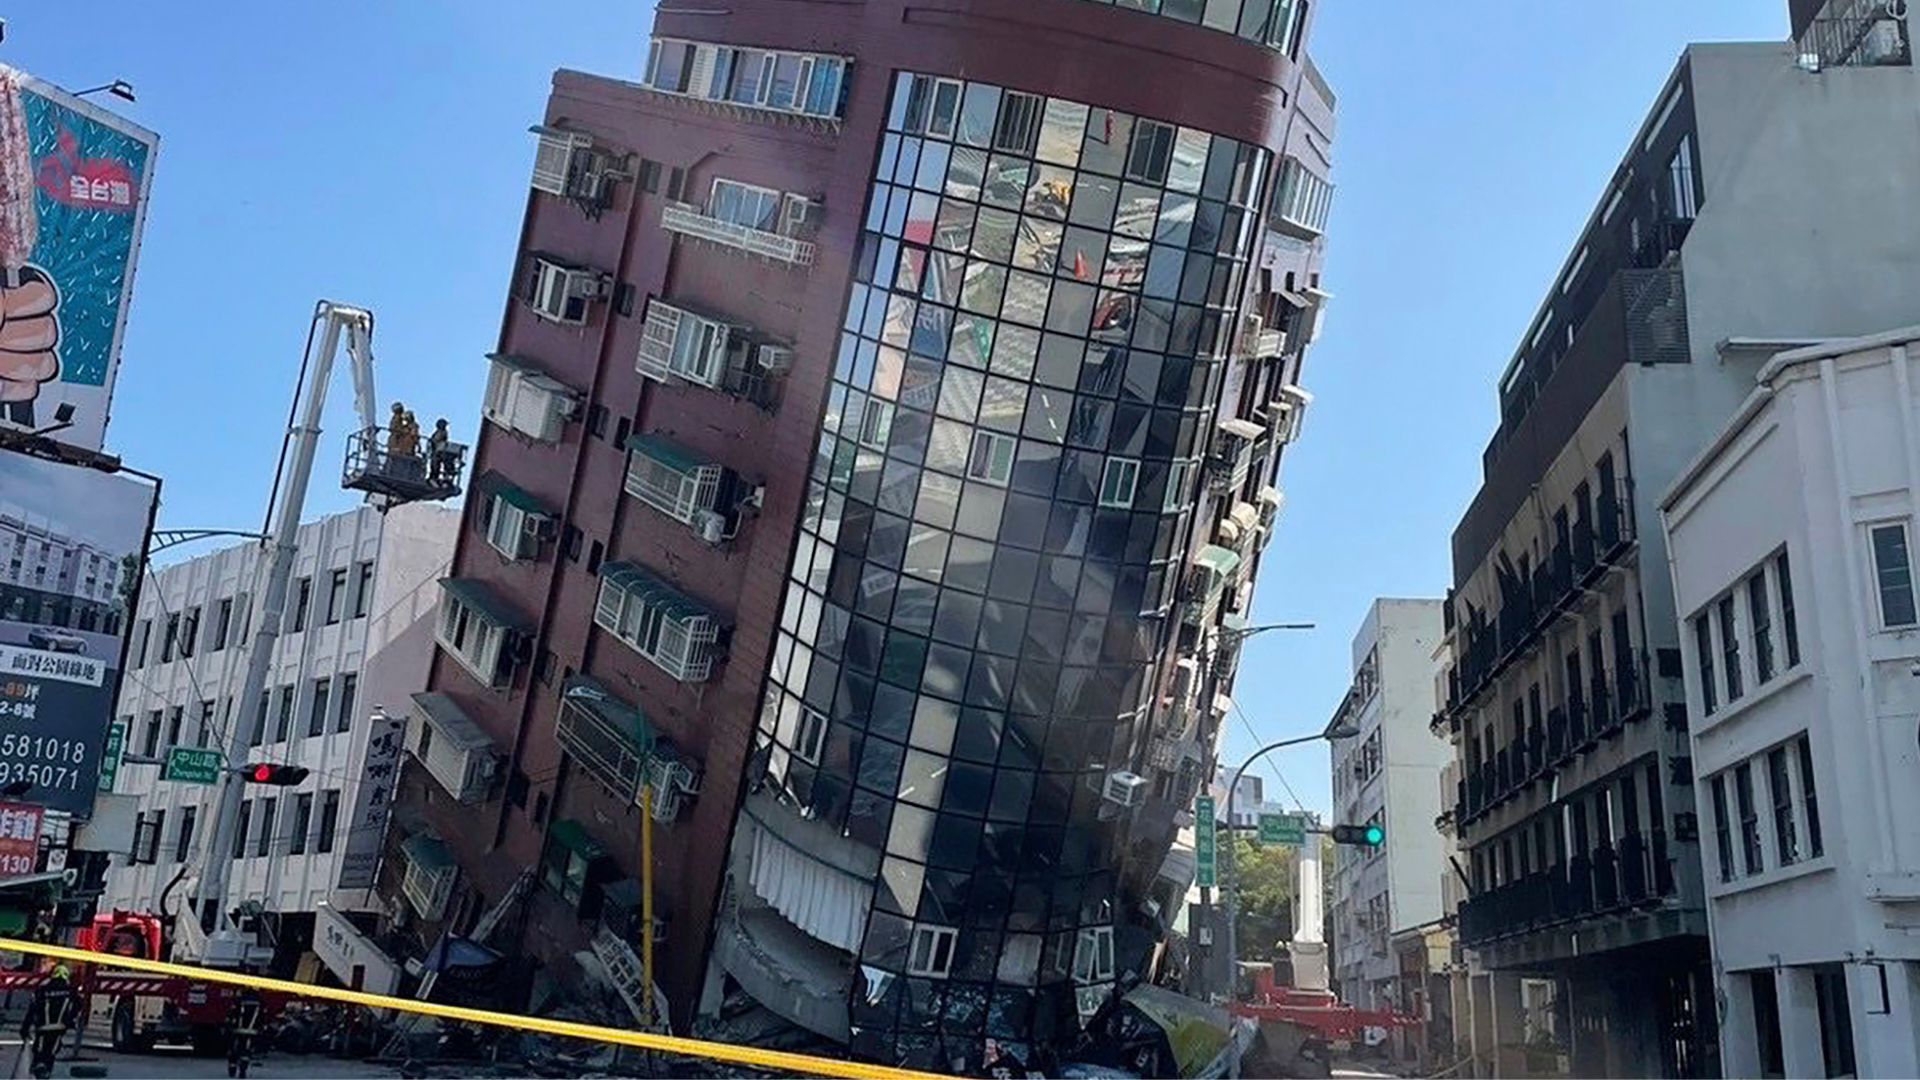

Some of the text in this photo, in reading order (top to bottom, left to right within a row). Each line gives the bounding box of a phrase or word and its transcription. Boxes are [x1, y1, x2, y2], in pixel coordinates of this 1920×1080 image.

[70, 175, 130, 205] 全台灣
[2, 734, 85, 764] 581018
[177, 751, 217, 768] 中山路
[0, 854, 30, 874] 130
